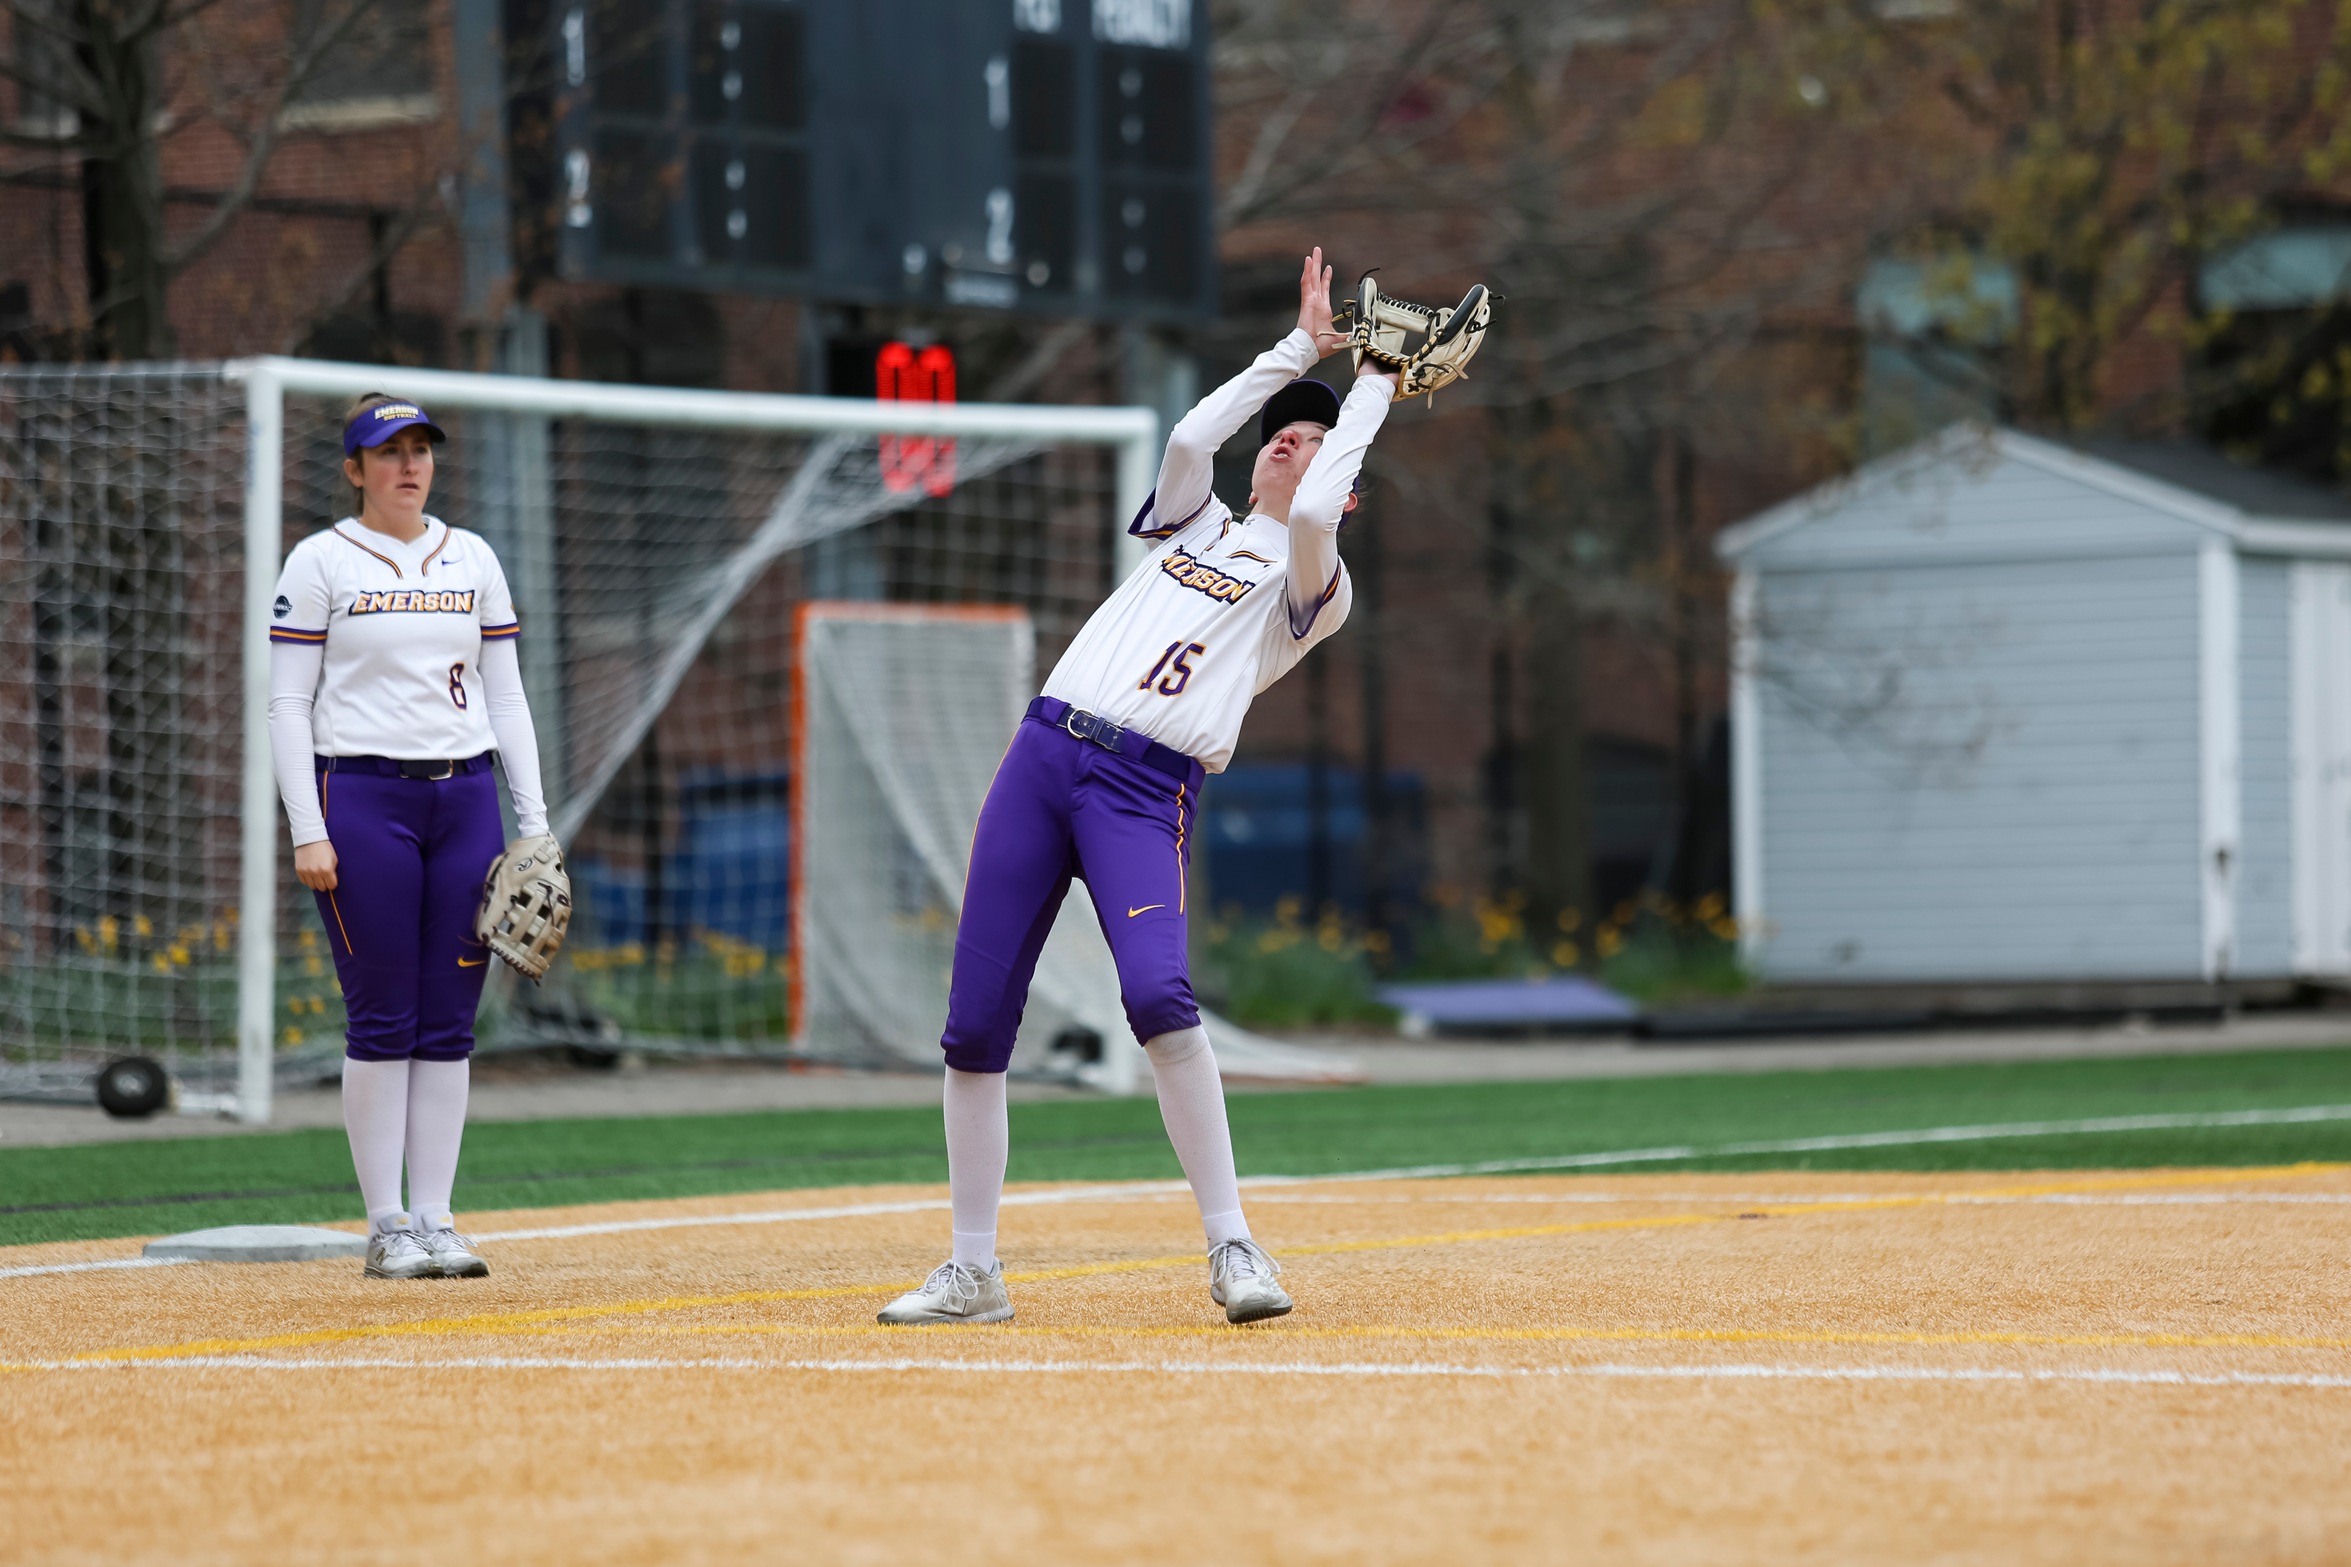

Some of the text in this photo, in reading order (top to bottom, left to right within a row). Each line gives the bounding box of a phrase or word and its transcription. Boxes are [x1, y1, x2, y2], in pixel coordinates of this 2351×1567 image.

[349, 590, 475, 615] EMERSON
[449, 661, 468, 711] 8
[1138, 640, 1206, 697] 15
